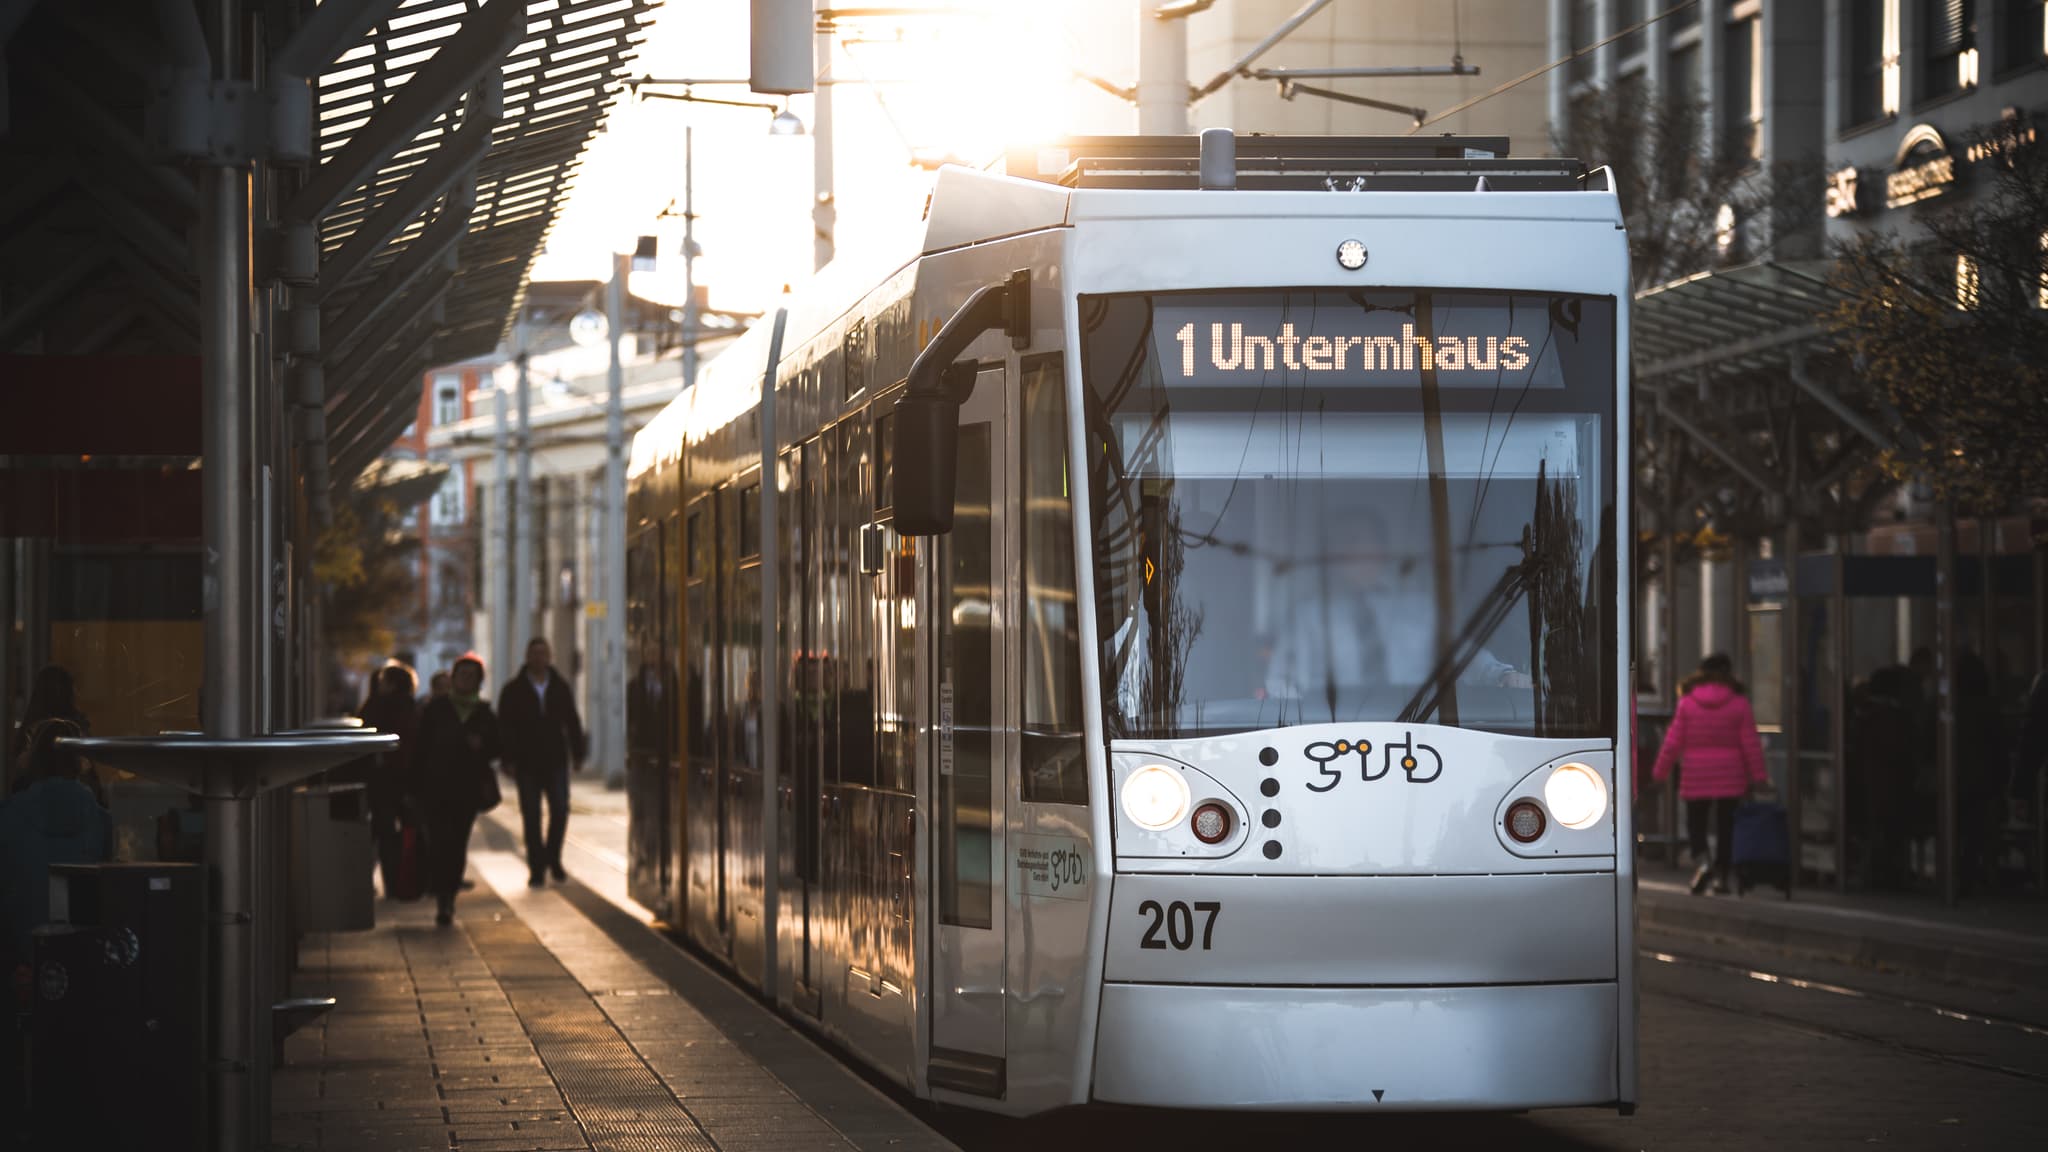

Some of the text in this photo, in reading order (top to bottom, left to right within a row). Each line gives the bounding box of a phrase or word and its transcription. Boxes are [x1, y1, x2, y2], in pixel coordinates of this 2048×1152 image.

[1176, 322, 1530, 376] 1 Untermhaus
[1138, 899, 1221, 951] 207
